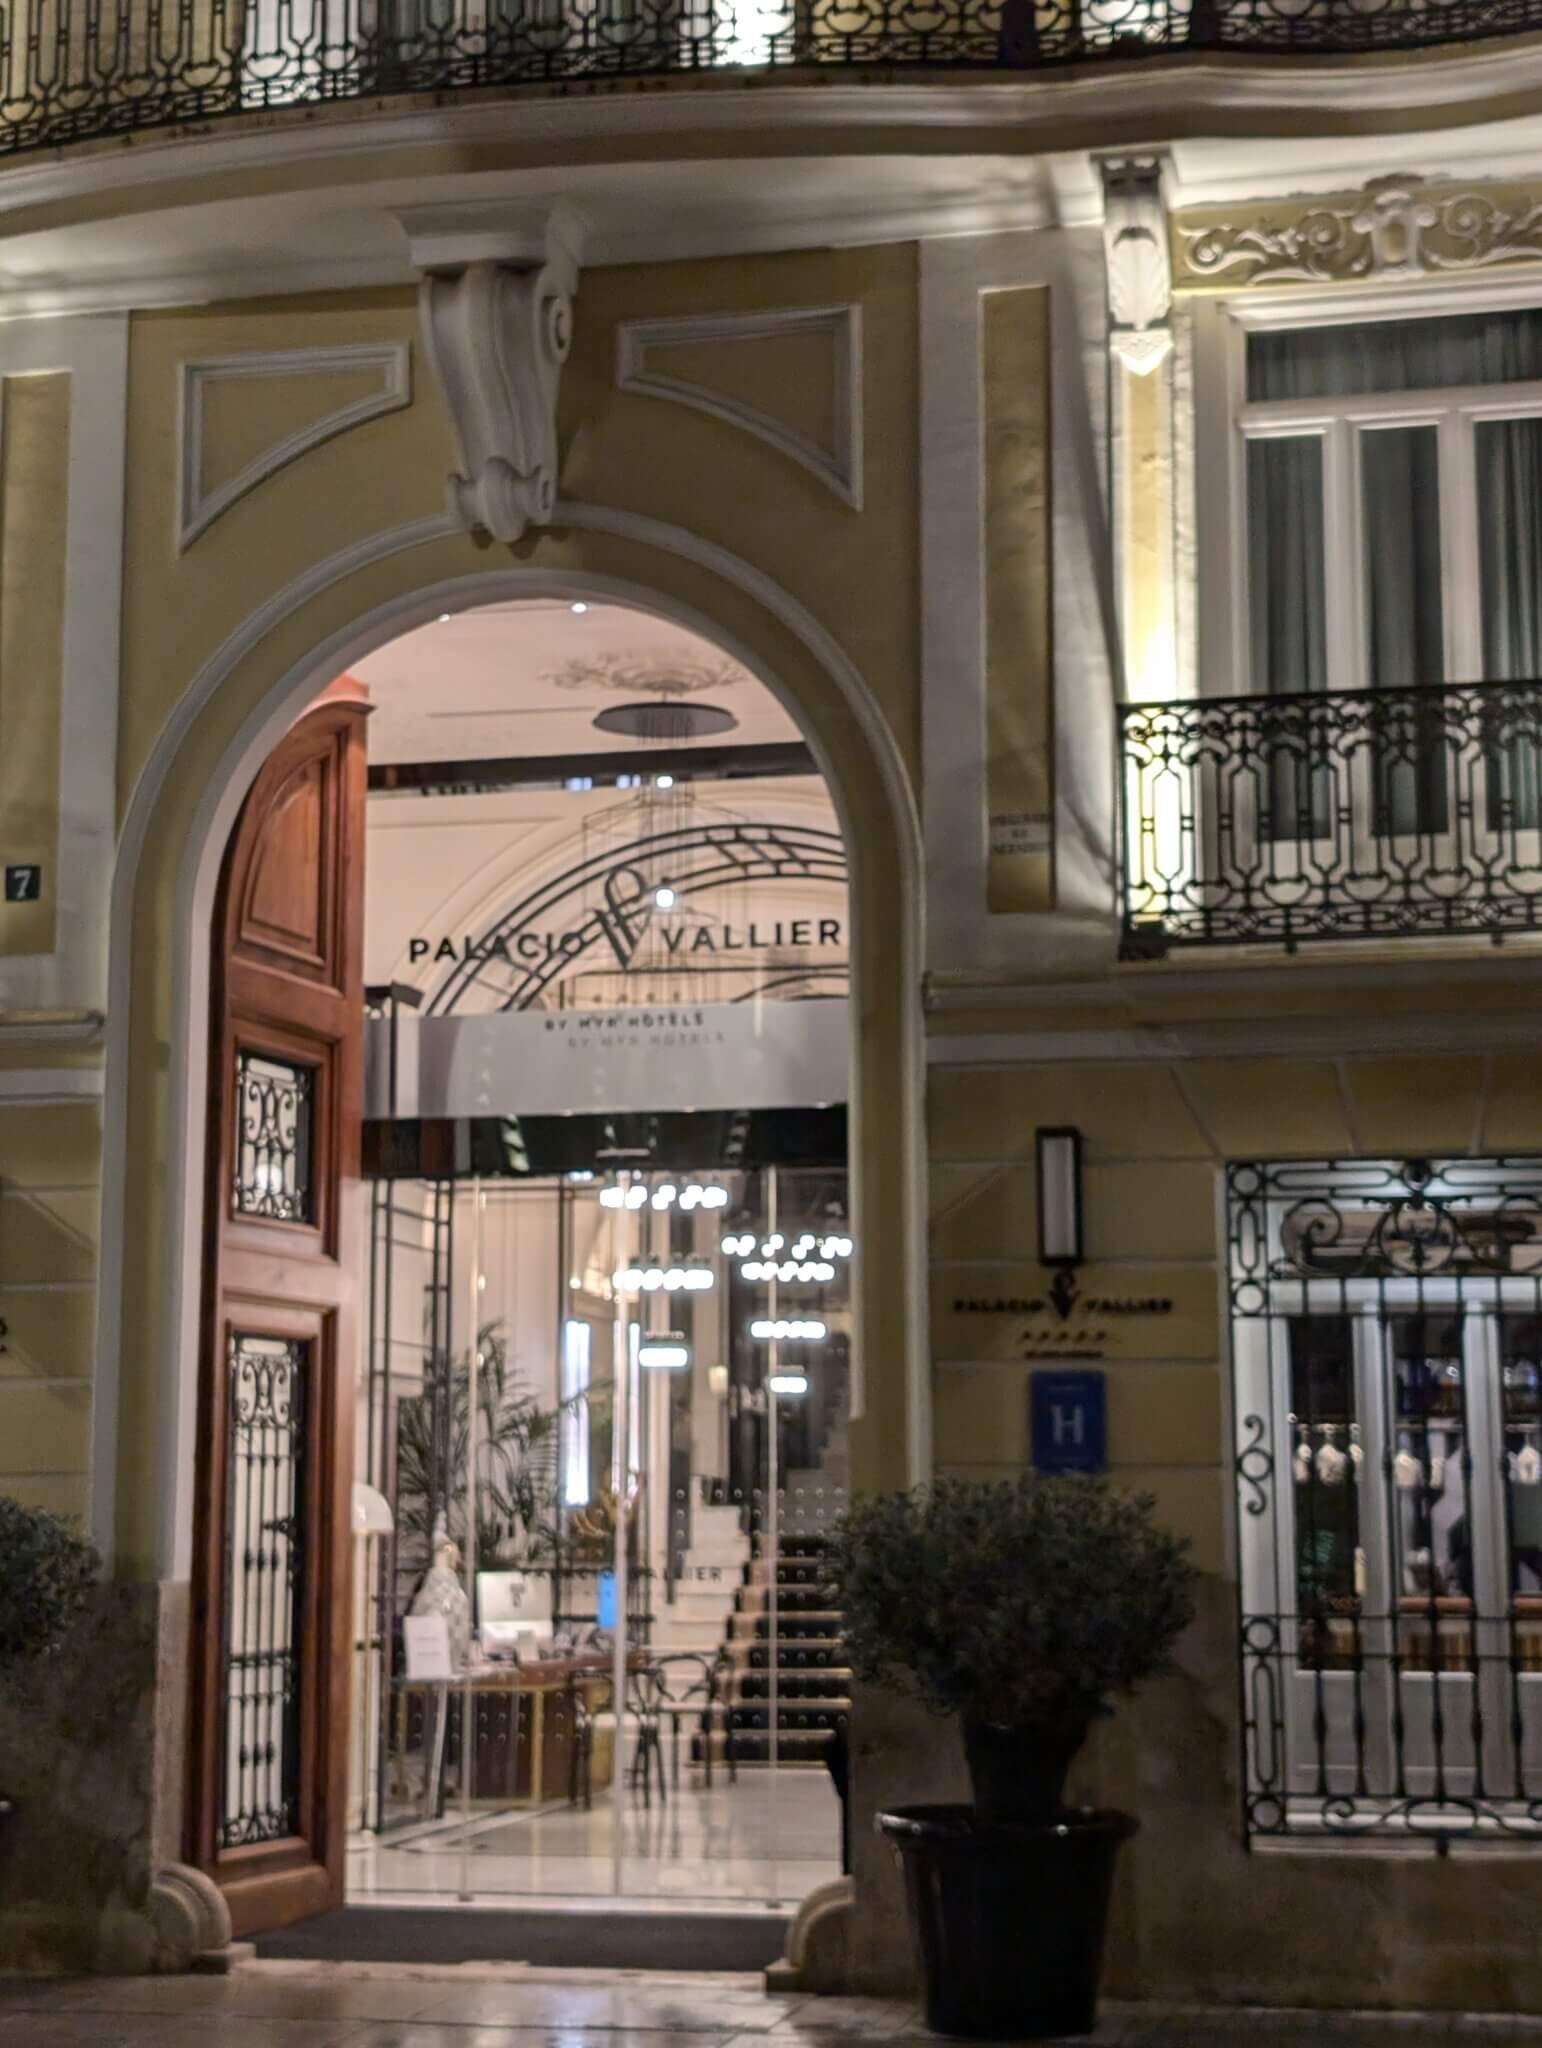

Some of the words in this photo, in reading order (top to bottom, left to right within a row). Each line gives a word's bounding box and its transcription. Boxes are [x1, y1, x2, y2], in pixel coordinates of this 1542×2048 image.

[14, 869, 32, 898] 7
[408, 931, 584, 963] PALACIO
[660, 919, 842, 953] VALLIER
[1050, 1404, 1086, 1445] H
